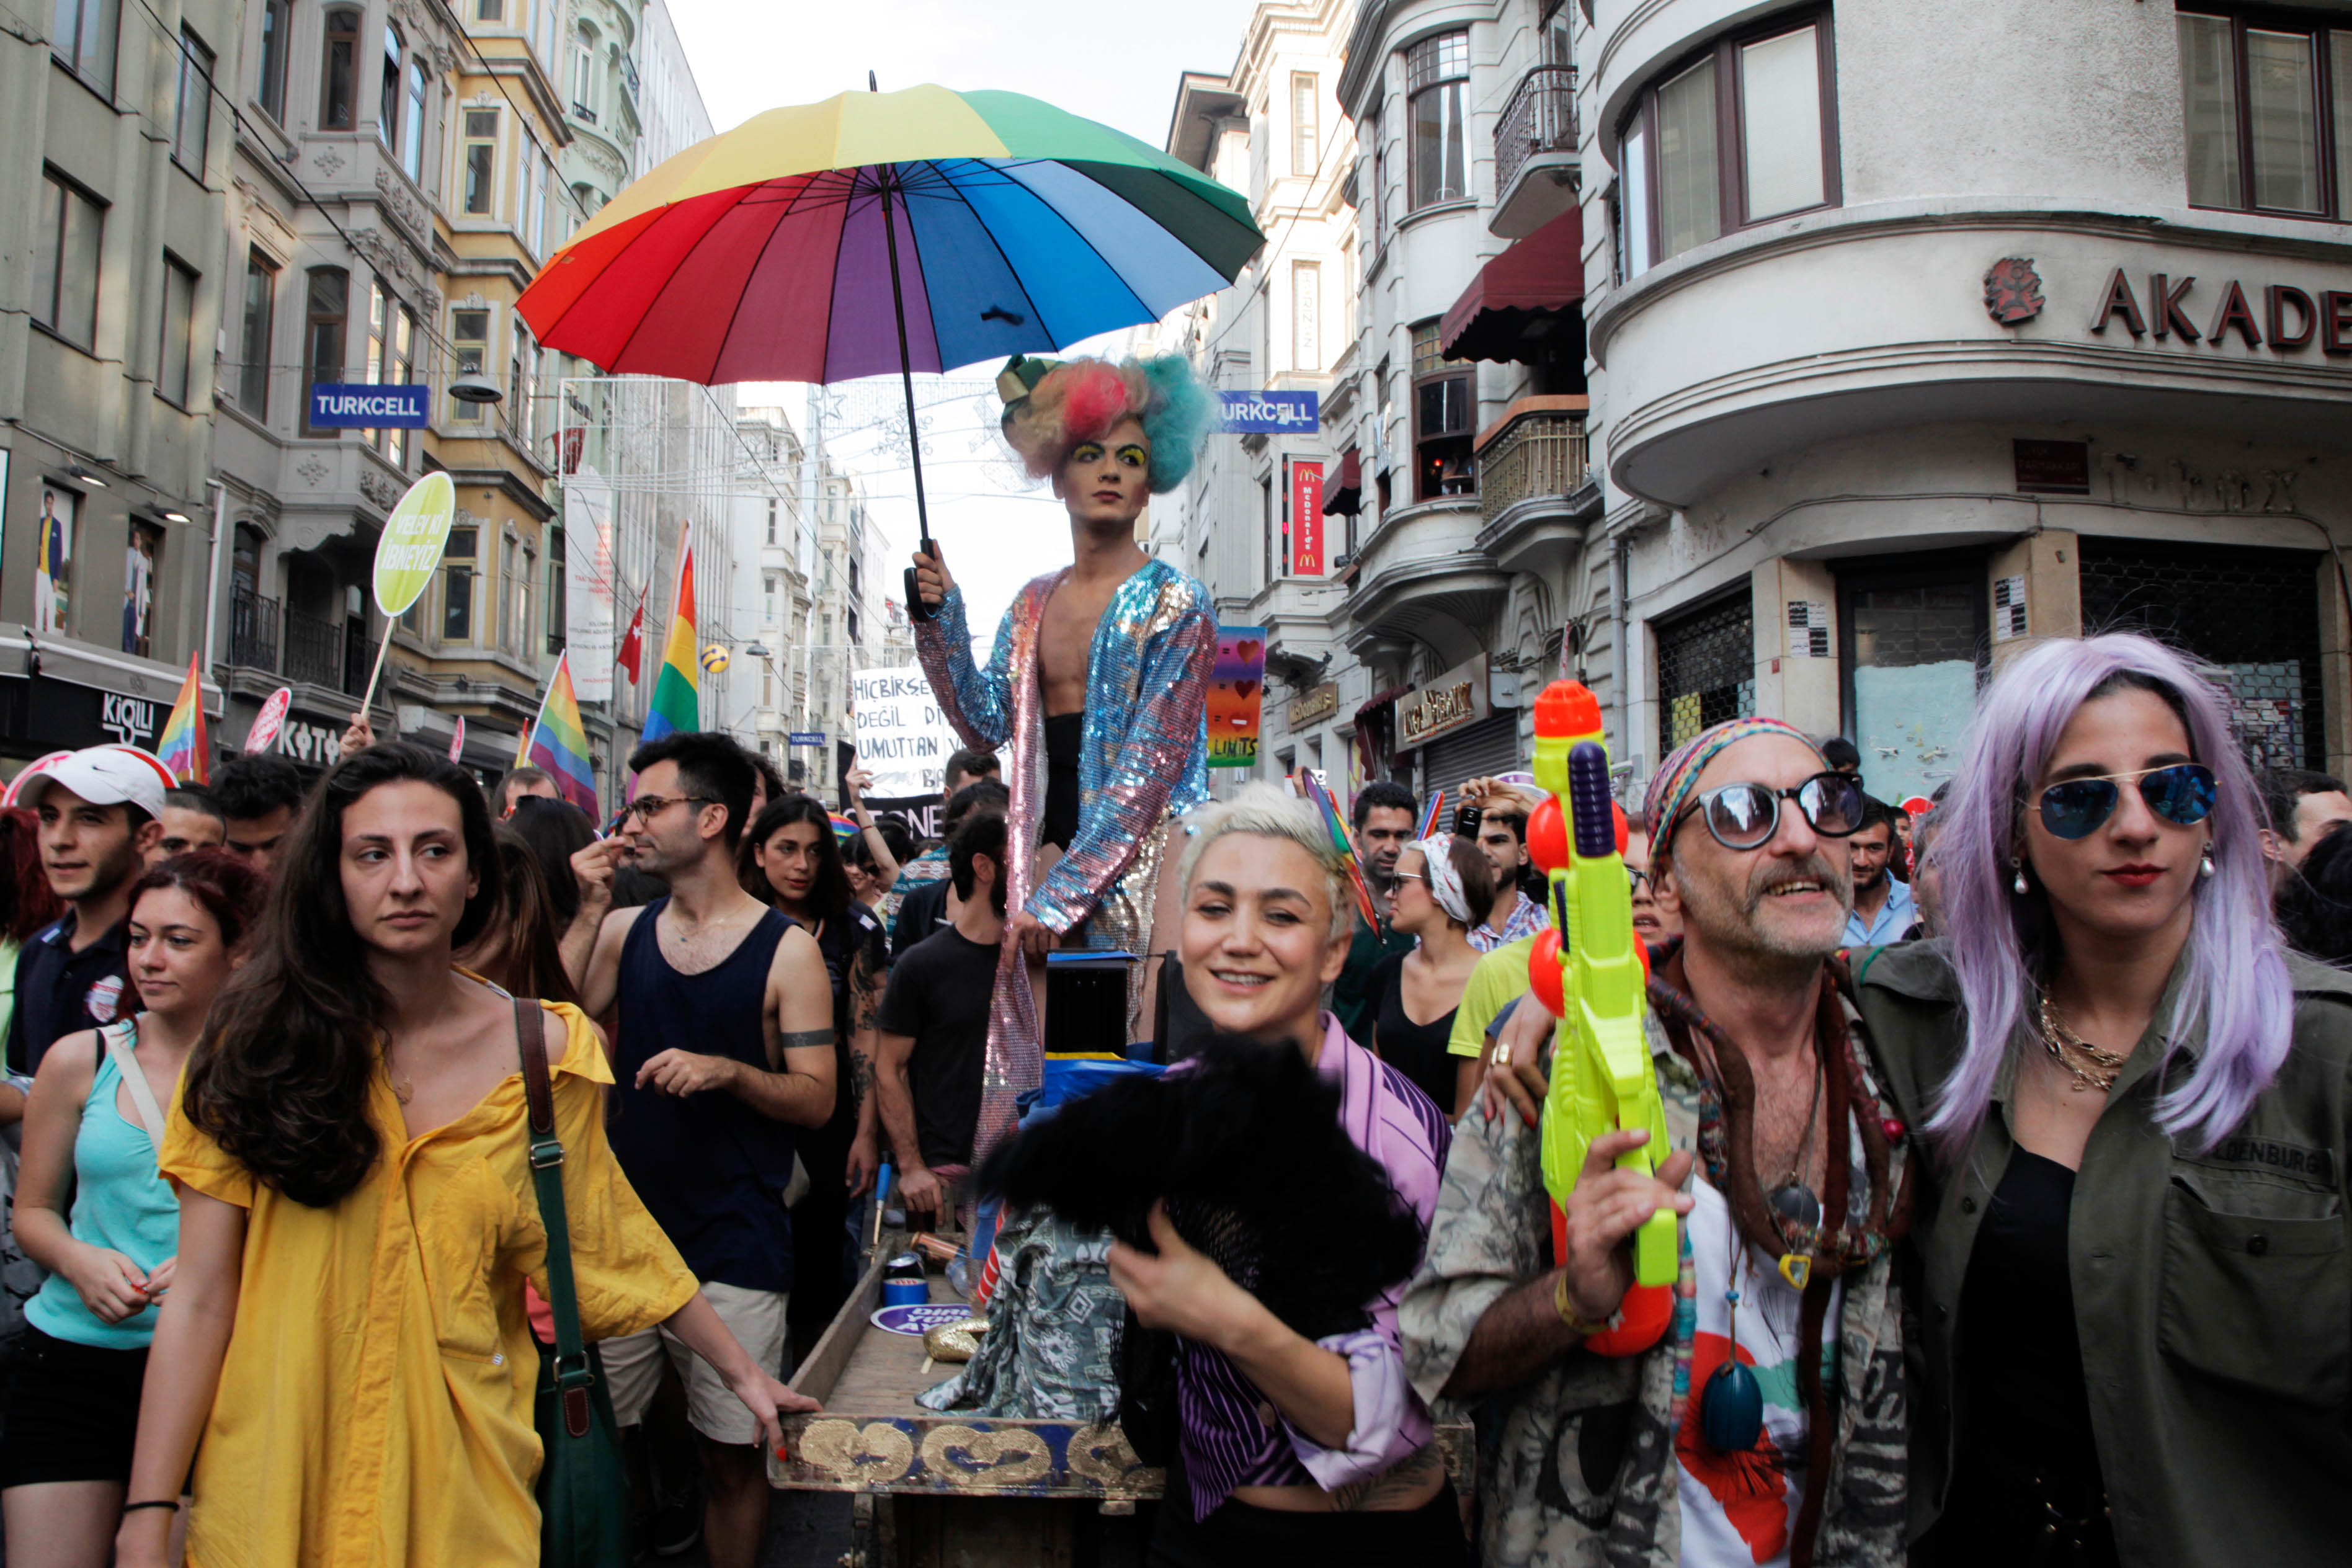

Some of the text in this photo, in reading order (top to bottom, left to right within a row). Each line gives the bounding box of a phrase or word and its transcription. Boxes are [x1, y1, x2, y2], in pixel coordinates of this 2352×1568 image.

[2090, 267, 2351, 354] AKADE
[317, 395, 421, 416] TURKCELL
[1221, 403, 1313, 421] URKCELL
[1303, 487, 1313, 550] McDonald's
[380, 538, 437, 571] İBNEYİZ
[853, 675, 931, 703] HİÇBİRŞE
[857, 705, 906, 729] DEĞİL
[278, 721, 340, 767] KOTO
[858, 736, 938, 760] UMUTTAN
[2214, 1140, 2318, 1174] LDENBURG
